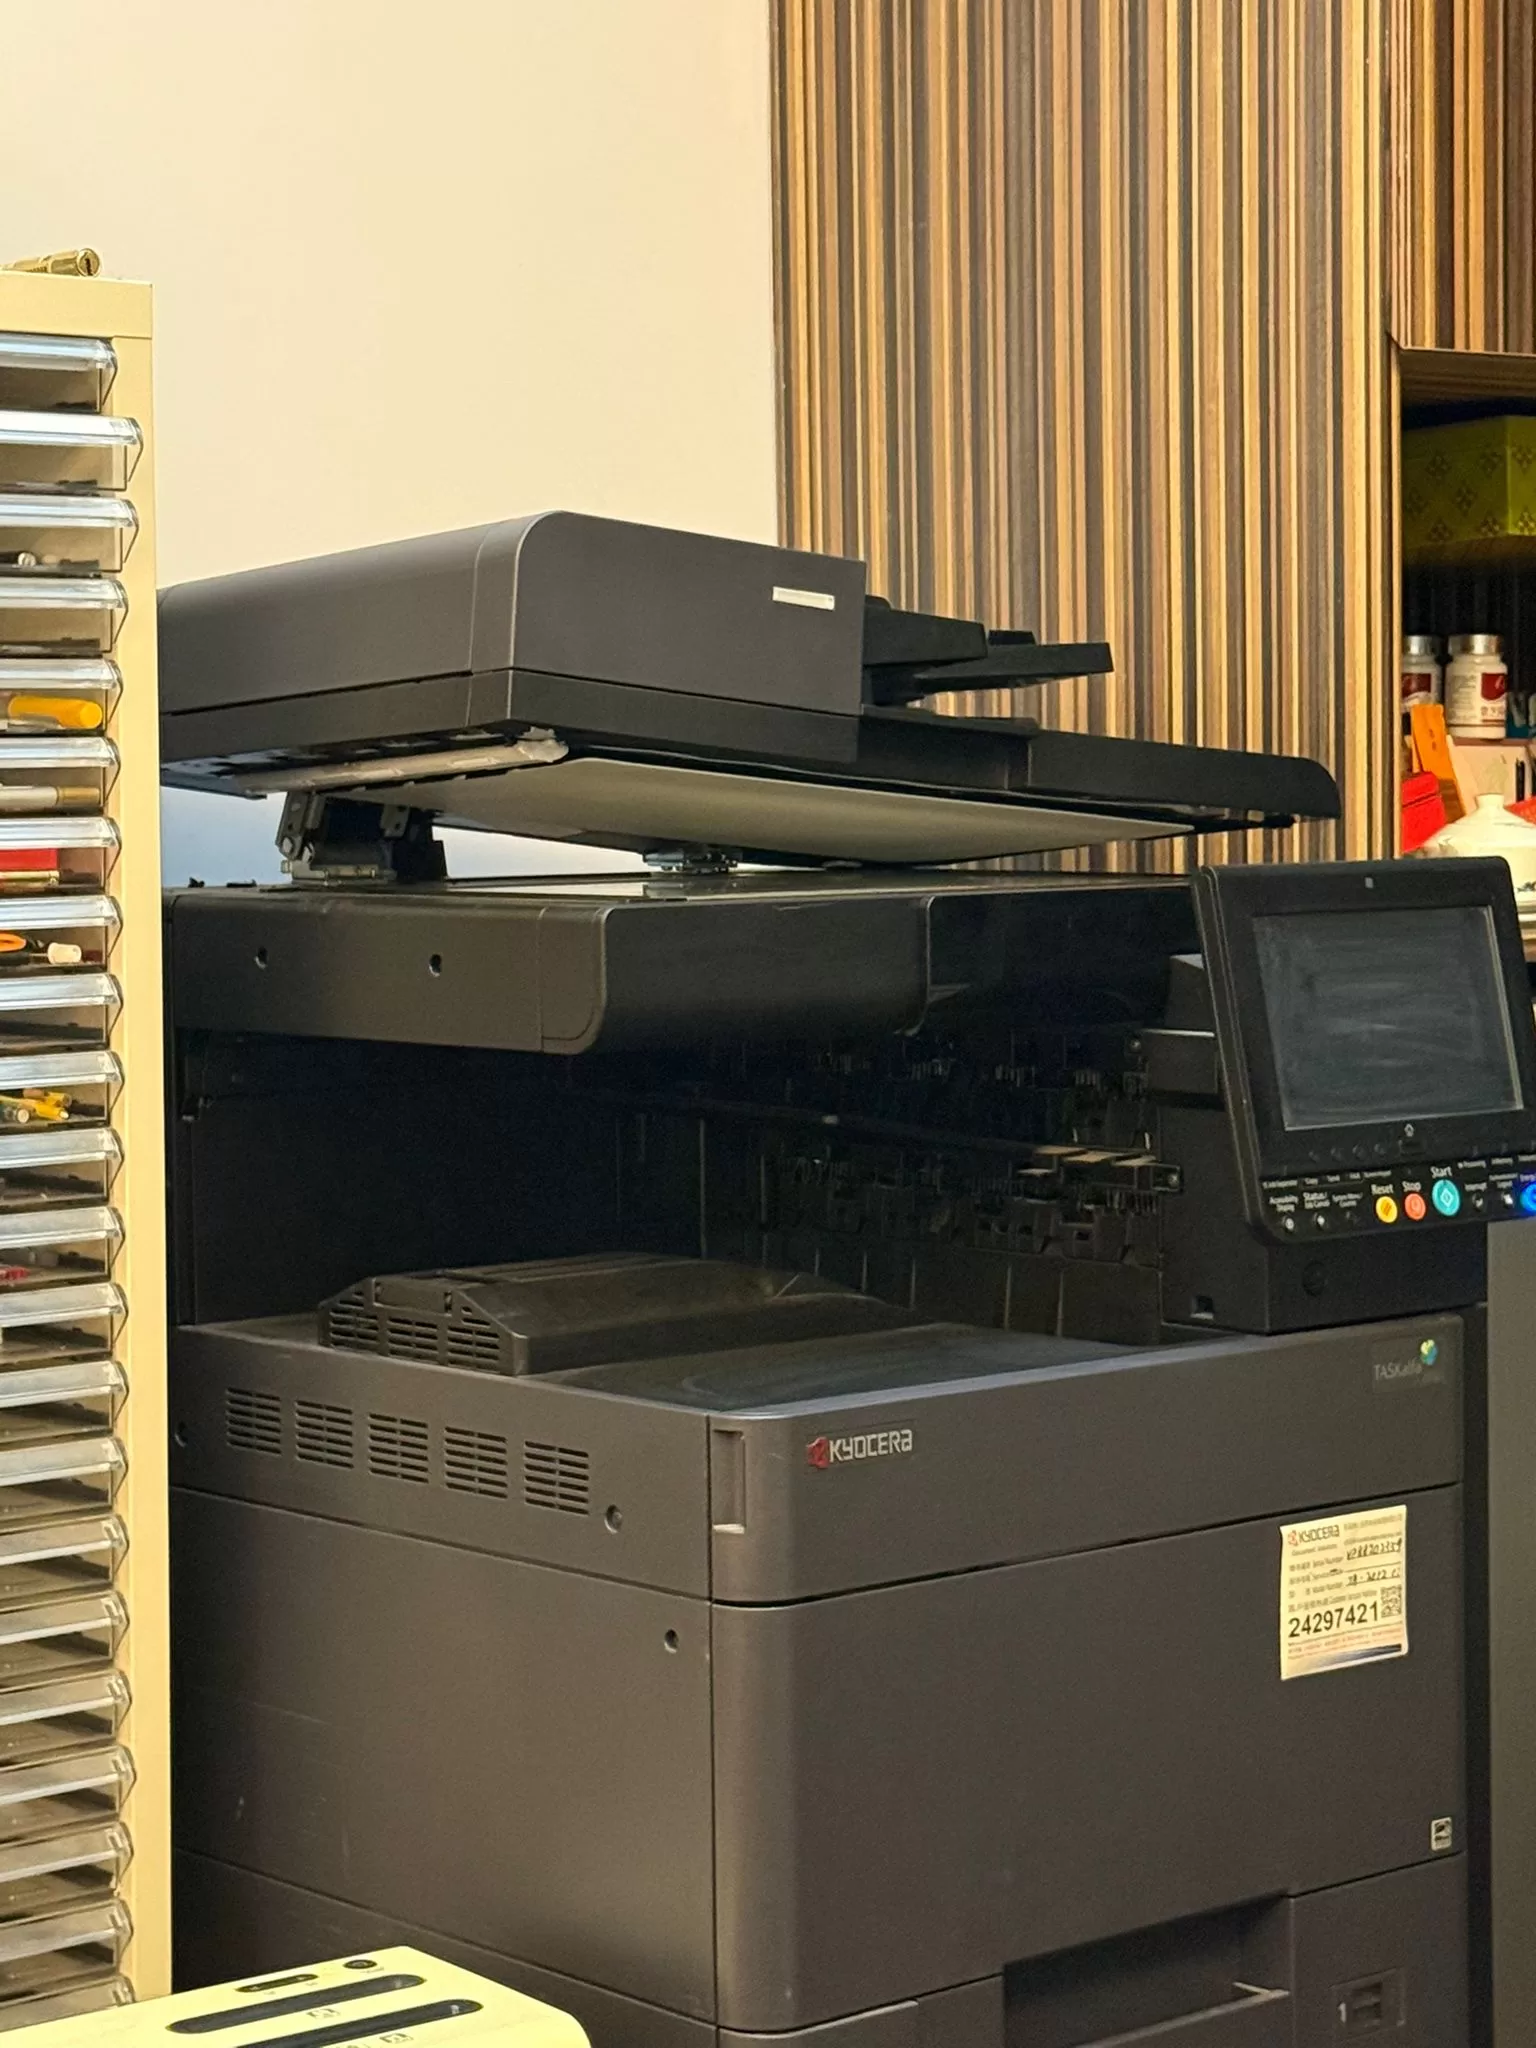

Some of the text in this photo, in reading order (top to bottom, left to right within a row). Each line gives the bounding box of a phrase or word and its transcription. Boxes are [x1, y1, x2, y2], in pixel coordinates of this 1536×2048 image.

[1430, 1165, 1453, 1179] Start
[1371, 1184, 1394, 1195] Reset
[1402, 1181, 1422, 1192] Stop
[829, 1429, 913, 1463] KYOCERA
[1299, 1524, 1340, 1543] KYOCERA
[1288, 1600, 1378, 1638] 24297421
